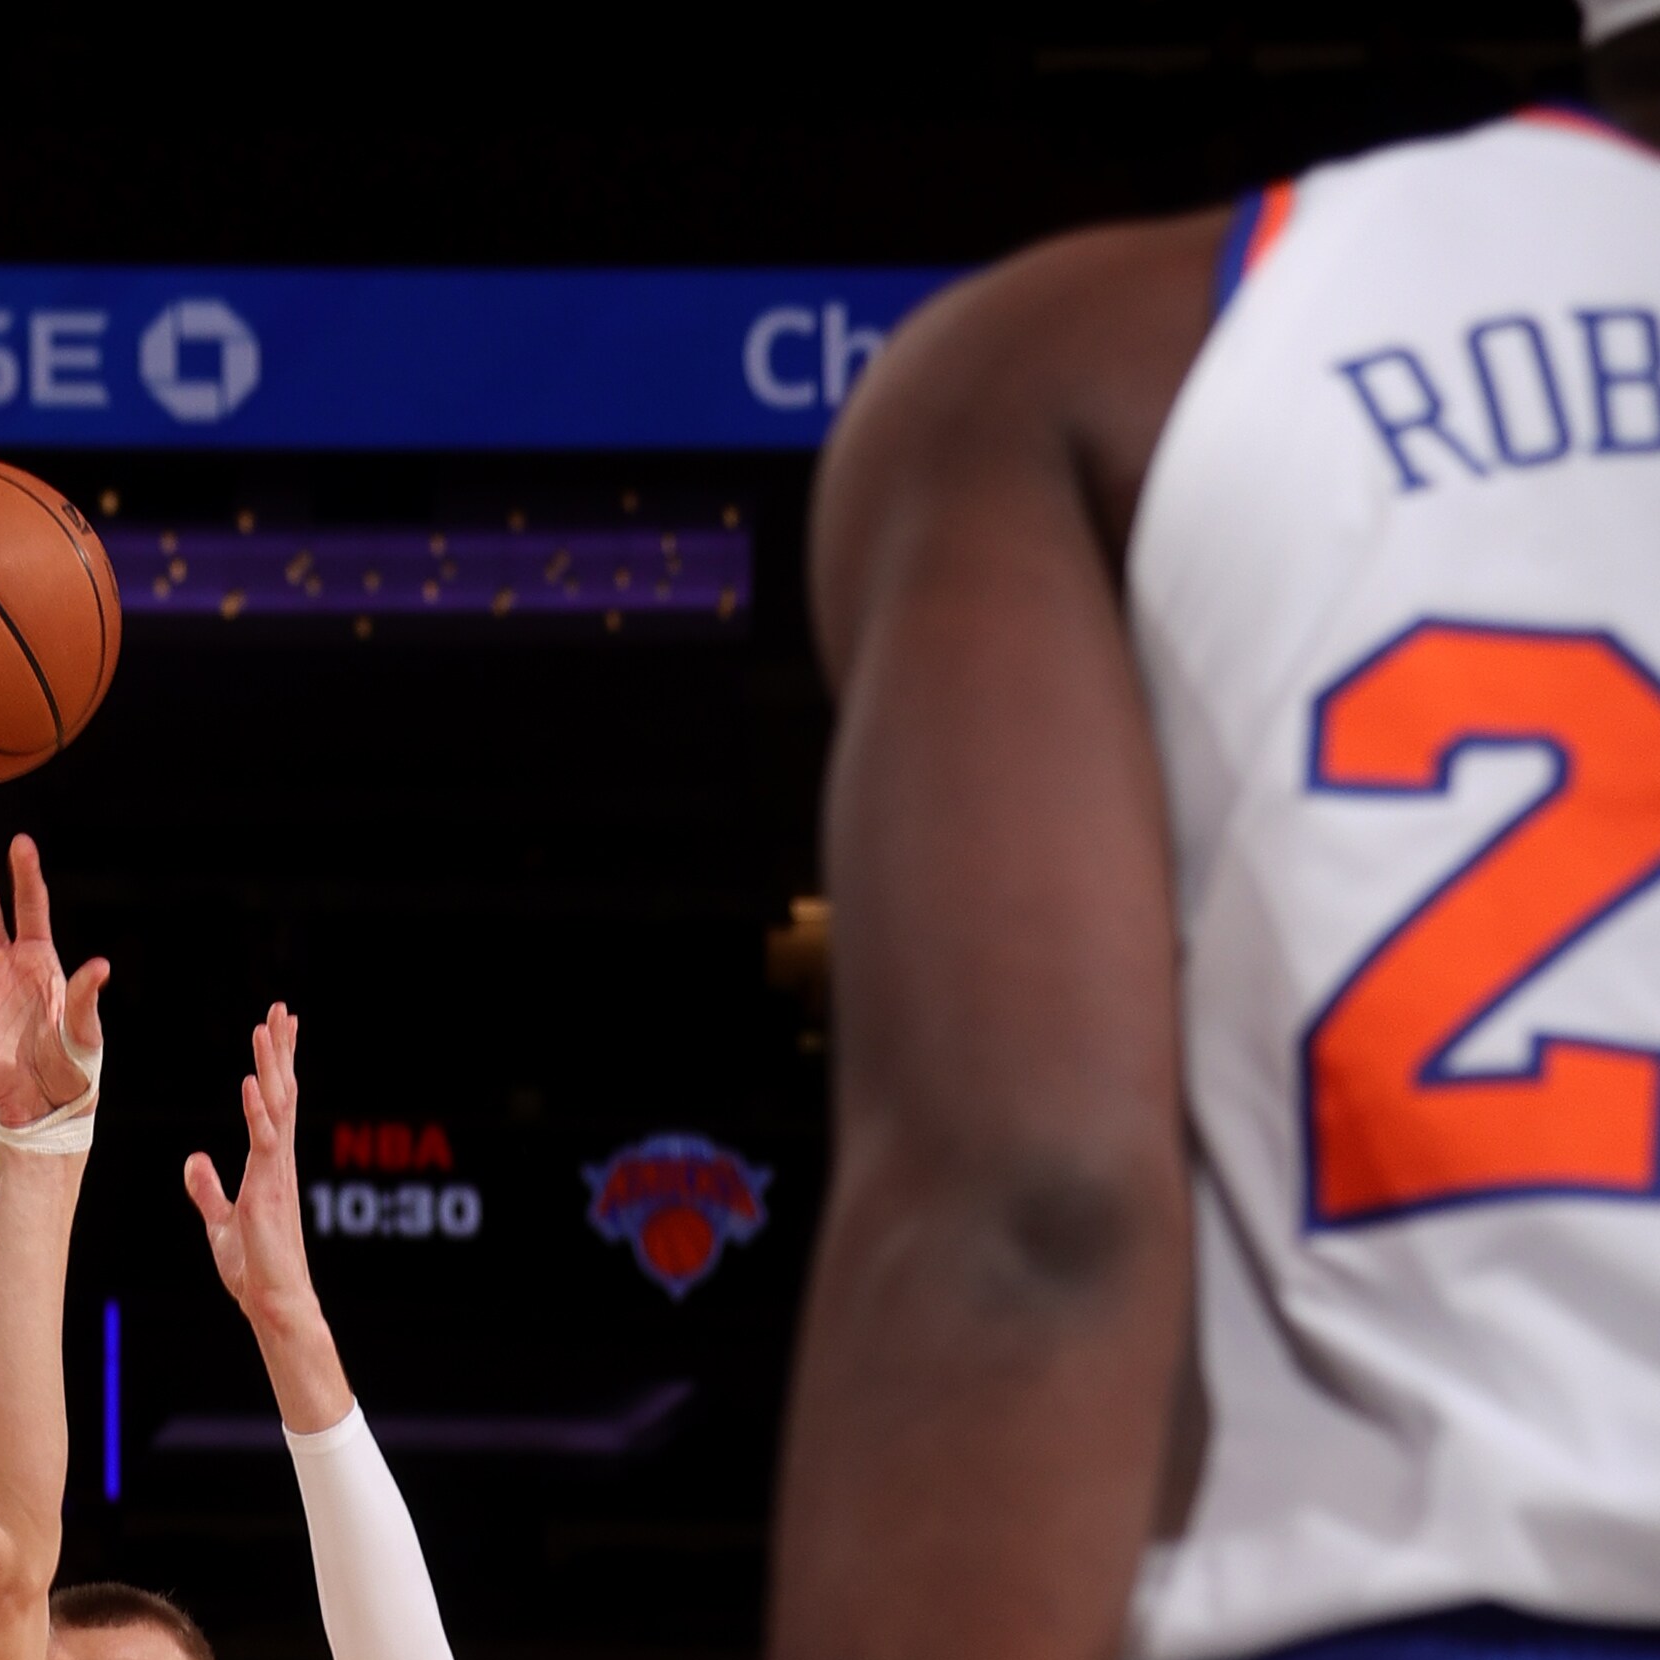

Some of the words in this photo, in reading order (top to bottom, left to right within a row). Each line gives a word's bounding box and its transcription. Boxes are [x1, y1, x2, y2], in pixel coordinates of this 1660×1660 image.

[1332, 307, 1660, 492] ROB
[1298, 612, 1660, 1236] 2
[309, 1182, 482, 1239] 10:30
